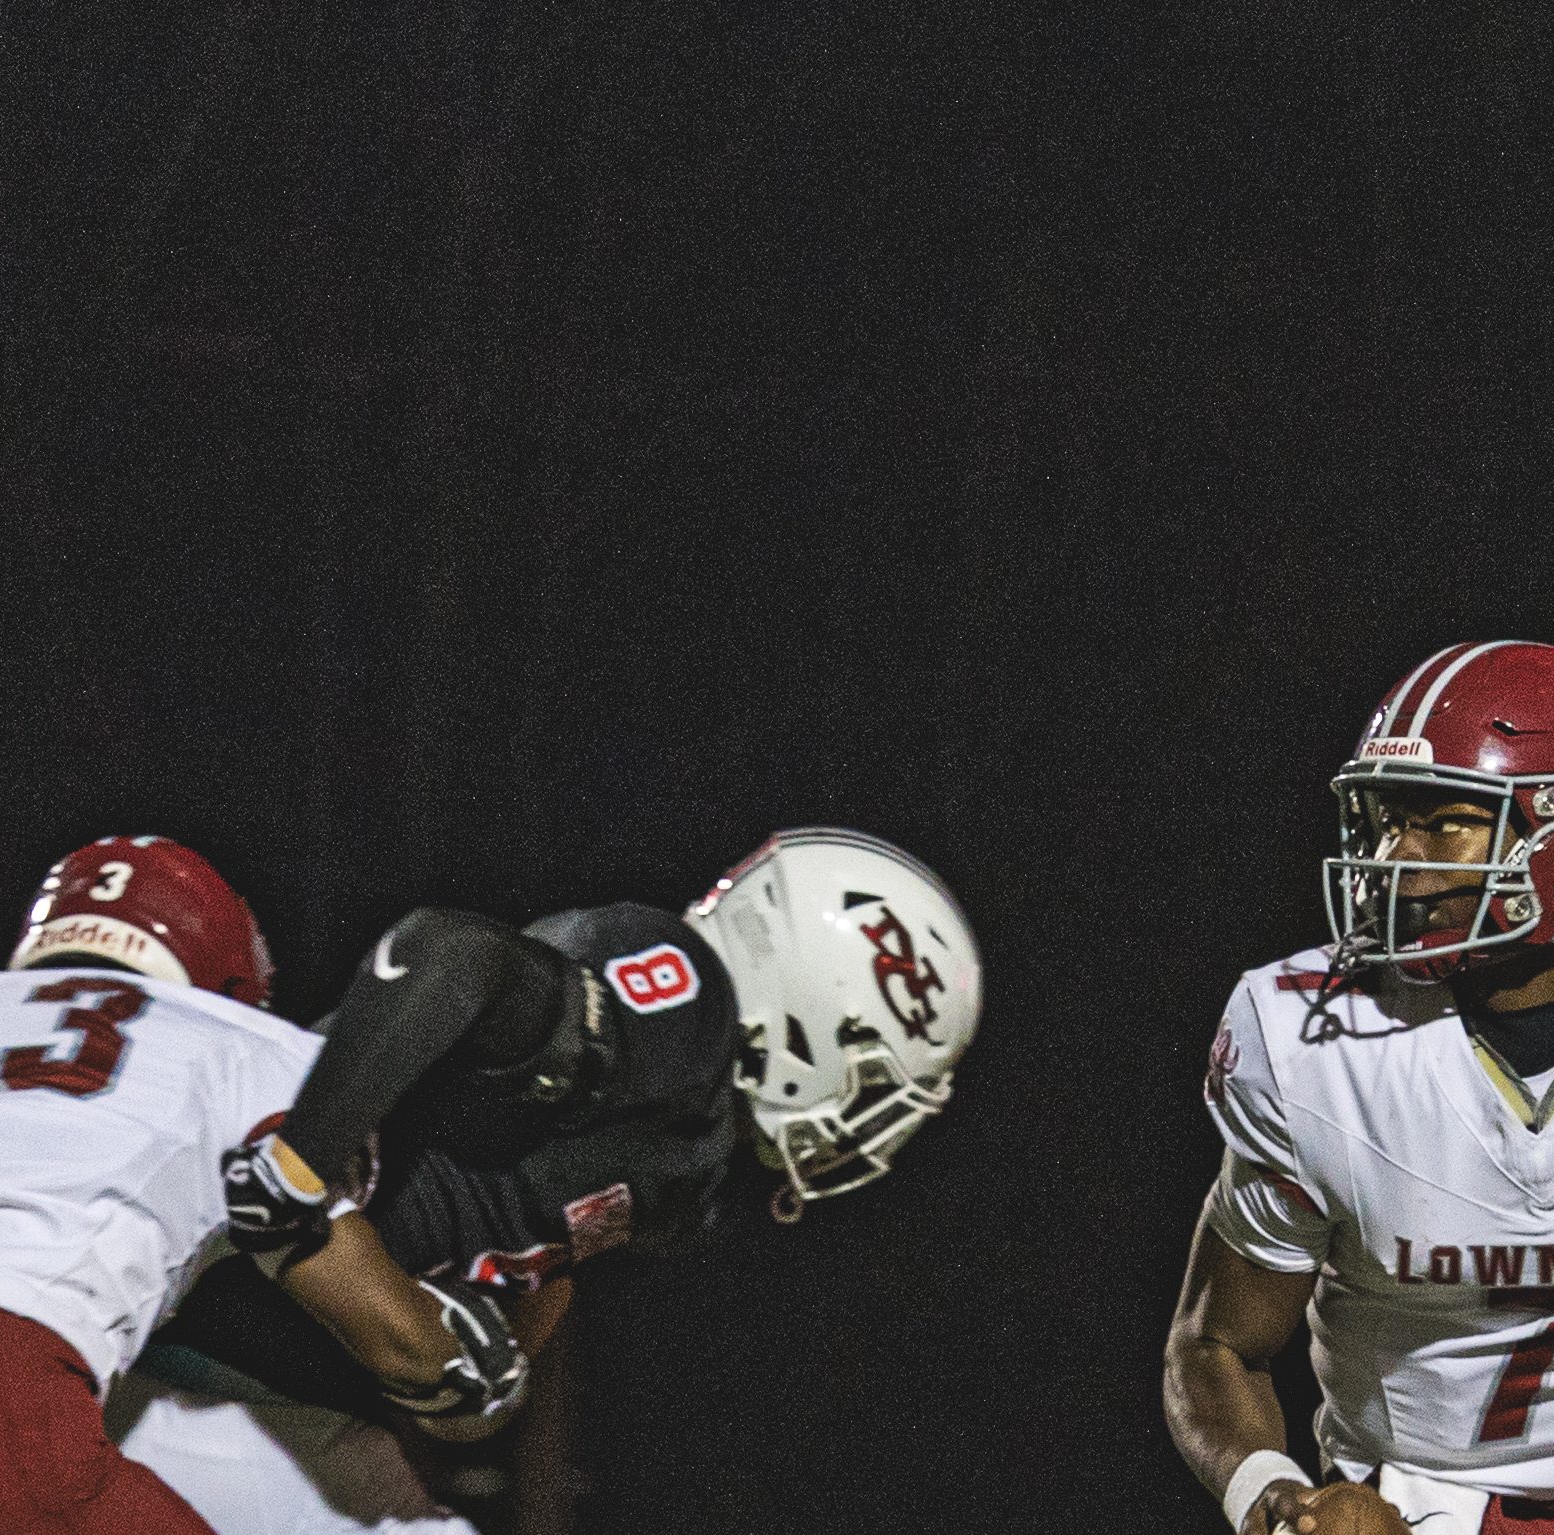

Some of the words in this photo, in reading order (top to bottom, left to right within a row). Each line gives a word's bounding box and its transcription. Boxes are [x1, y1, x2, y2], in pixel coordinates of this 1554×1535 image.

[1364, 741, 1422, 757] Riddell
[88, 860, 134, 902] 3
[604, 944, 701, 1015] 8
